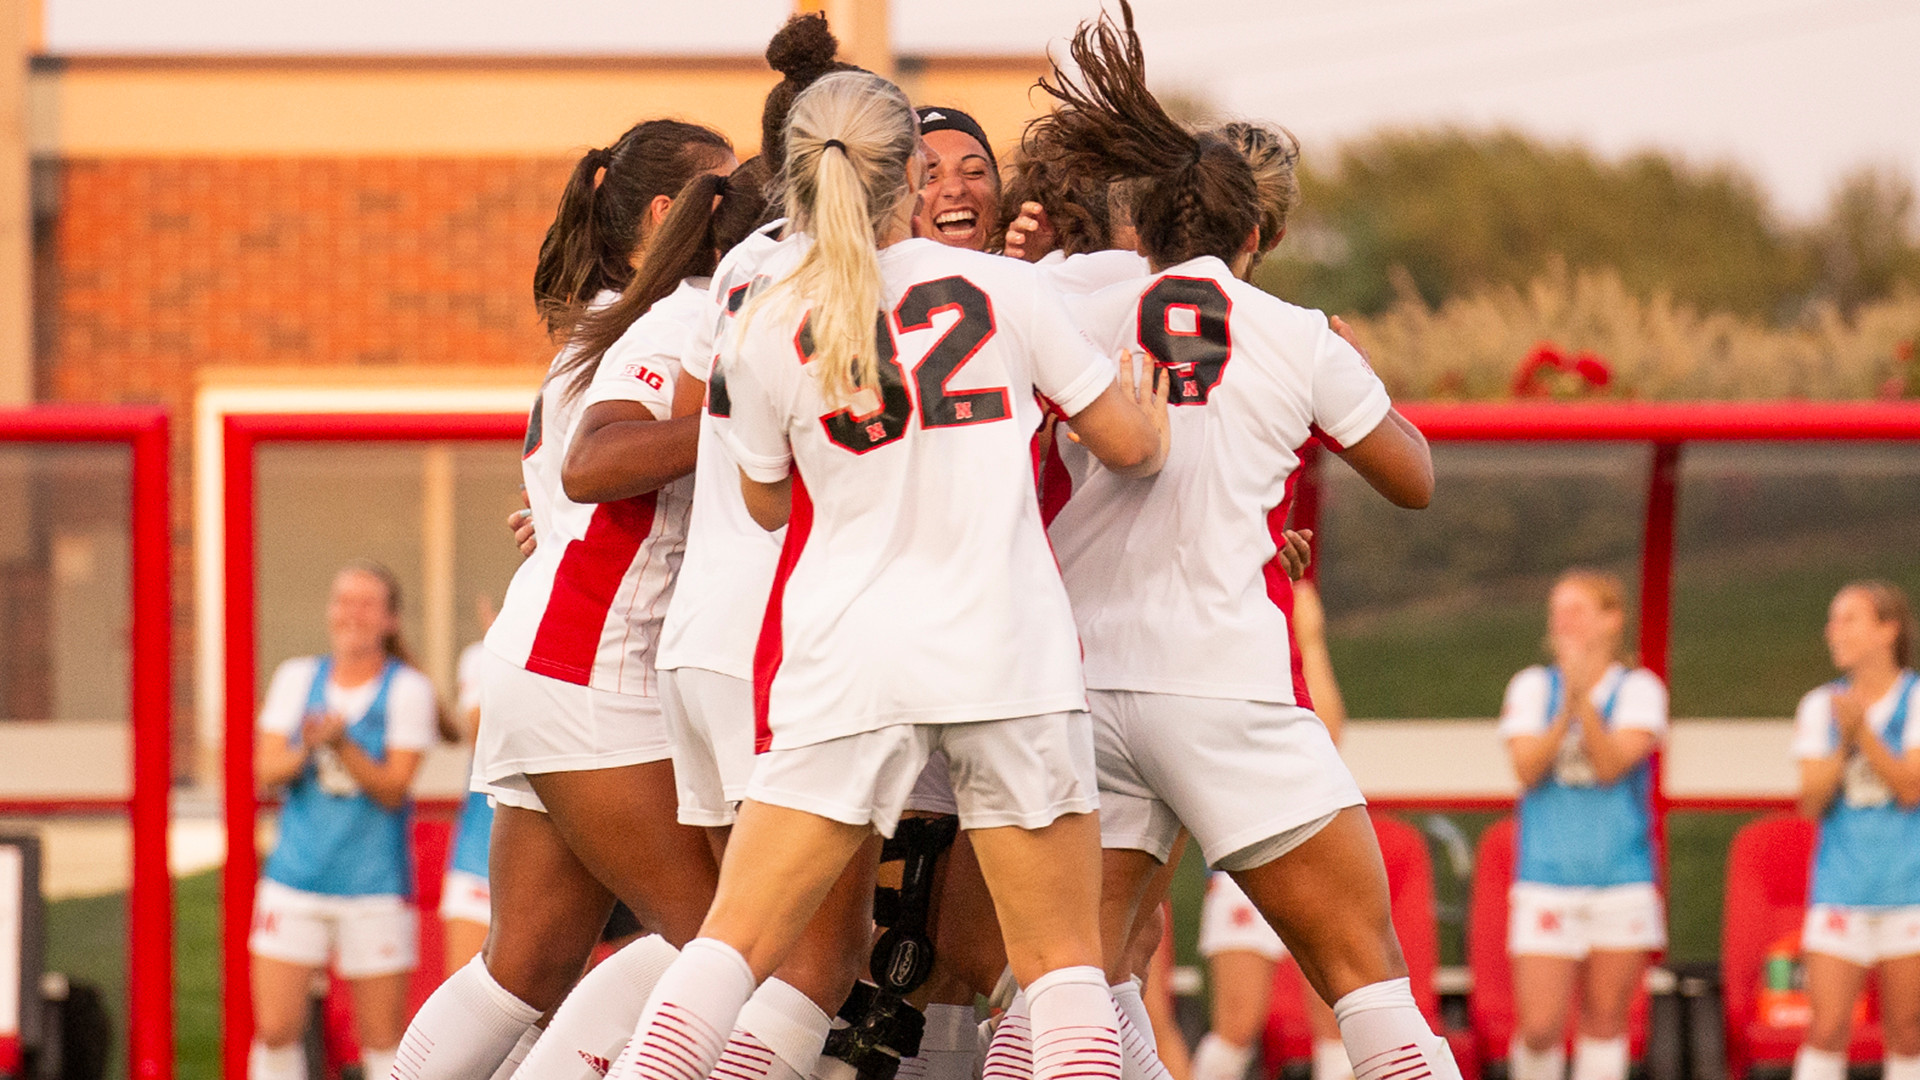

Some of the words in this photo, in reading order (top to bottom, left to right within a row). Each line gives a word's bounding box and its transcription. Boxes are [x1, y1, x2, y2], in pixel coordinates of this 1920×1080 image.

[793, 275, 1013, 456] 32
[1137, 274, 1234, 407] 9
[1182, 380, 1199, 397] N
